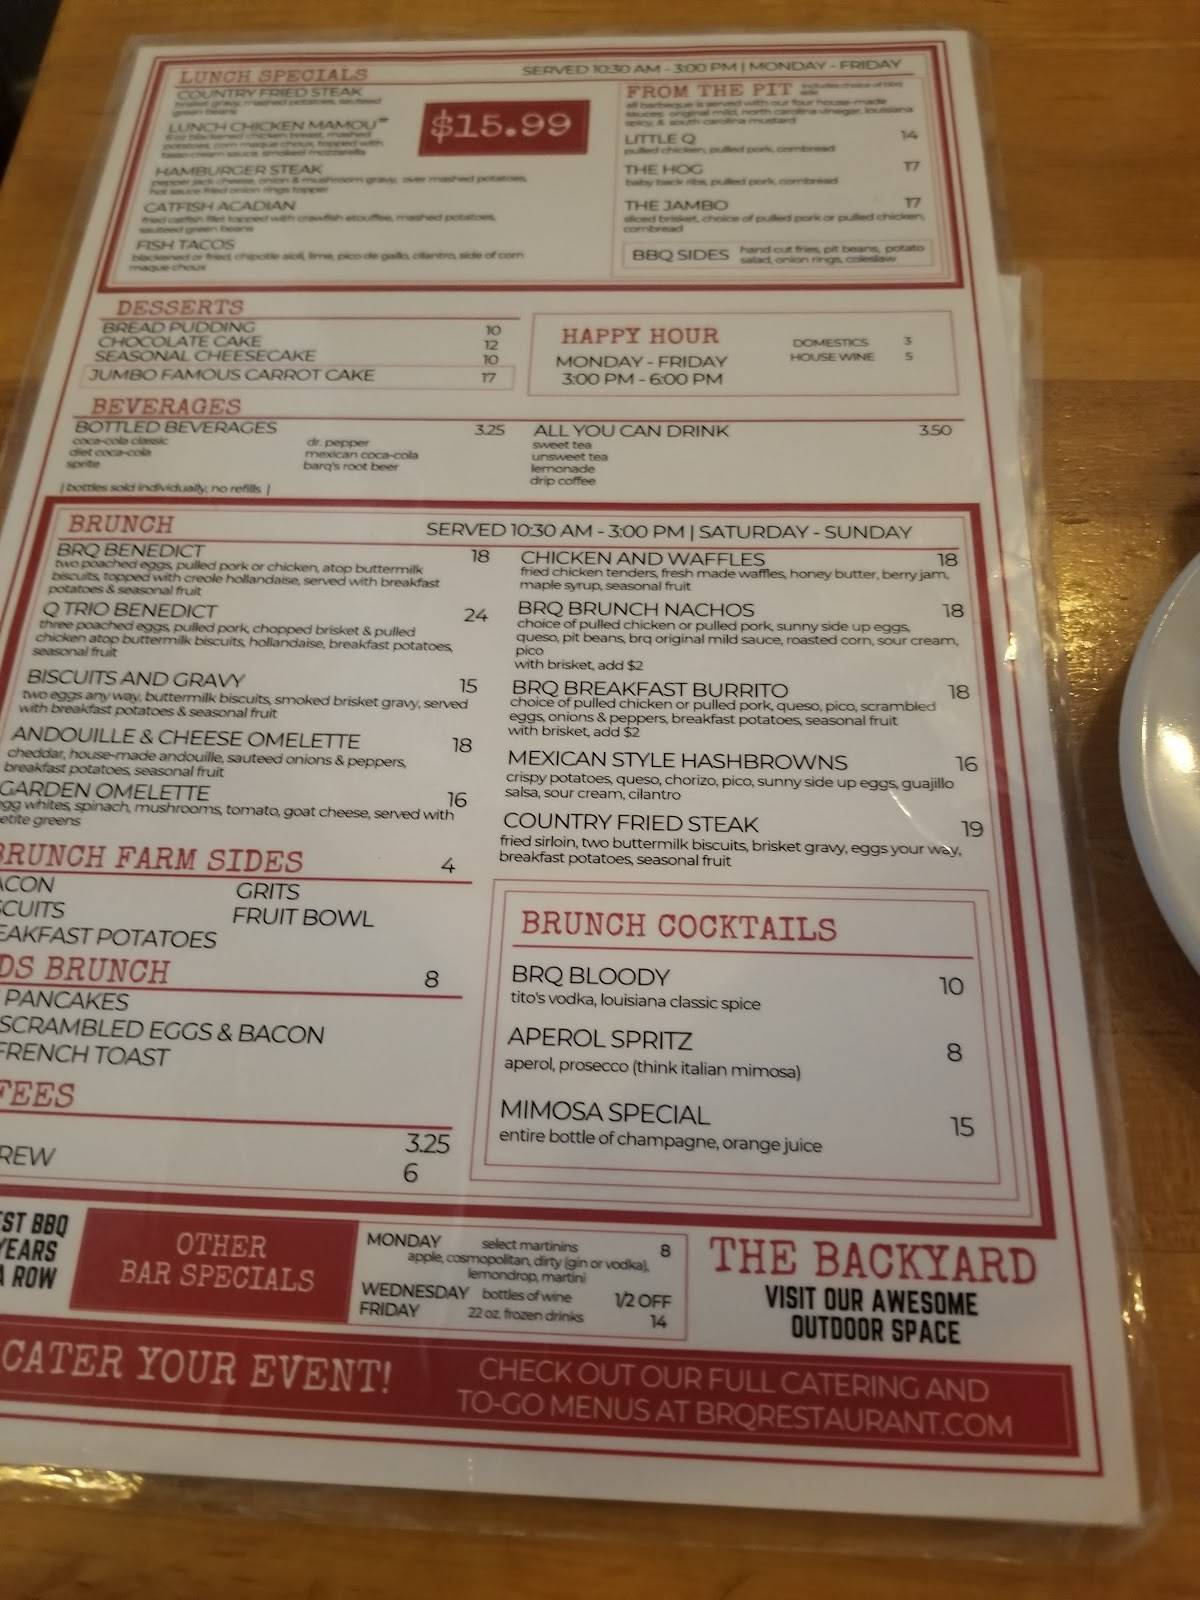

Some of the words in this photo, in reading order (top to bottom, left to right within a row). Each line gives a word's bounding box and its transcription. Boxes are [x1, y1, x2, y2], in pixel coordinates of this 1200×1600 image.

[181, 69, 252, 84] LUNCH
[260, 68, 368, 83] SPECIALS
[523, 64, 590, 75] SERVED
[592, 64, 632, 75] 10:30
[634, 63, 661, 75] AM
[674, 62, 708, 73] 3:00
[710, 61, 738, 72] PM
[749, 60, 827, 72] MONDAY
[840, 58, 902, 70] FRIDAY
[628, 83, 688, 98] FROM
[698, 82, 745, 97] THE
[753, 82, 794, 97] PIT
[431, 109, 572, 143] $15.99
[625, 133, 677, 146] LITTLE
[681, 132, 698, 148] Q
[900, 129, 919, 141] 14
[155, 165, 266, 178] HAMBURGER
[270, 164, 322, 176] STEAK
[624, 164, 658, 175] THE
[662, 164, 704, 176] HOG
[904, 159, 921, 172] 17
[624, 199, 659, 211] THE
[664, 200, 728, 212] JAMBO
[904, 196, 922, 209] 17
[136, 239, 175, 251] FISH
[179, 239, 235, 251] TACOS
[633, 248, 676, 263] BBQ
[677, 248, 730, 261] SIDES
[116, 299, 245, 317] DESSERTS
[103, 321, 167, 333] BREAD
[169, 321, 256, 334] PUDDING
[486, 324, 503, 337] 10
[562, 327, 641, 344] HAPPY
[650, 327, 720, 345] HOUR
[793, 337, 869, 348] DOMESTICS
[904, 336, 912, 345] 3
[556, 355, 643, 369] MONDAY
[659, 355, 728, 368] FRIDAY
[790, 352, 836, 362] HOUSE
[838, 352, 875, 362] WINE
[905, 352, 914, 361] 5
[89, 368, 158, 381] JUMBO
[161, 368, 241, 381] FAMOUS
[244, 366, 322, 381] CARROT
[324, 367, 376, 382] CAKE
[481, 372, 496, 383] 17
[91, 397, 242, 415] BEVERAGES
[75, 420, 161, 434] BOTTLED
[164, 420, 278, 435] BEVERAGES
[474, 422, 506, 436] 3.25
[533, 424, 570, 437] ALL
[572, 424, 616, 437] YOU
[620, 424, 661, 438] CAN
[667, 424, 729, 438] DRINK
[919, 424, 953, 437] 3.50
[305, 449, 360, 460] mexican
[360, 449, 420, 461] coca-cola
[530, 474, 556, 488] drip
[557, 475, 596, 487] coffee
[68, 514, 175, 534] BRUNCH
[57, 543, 101, 559] BRQ
[104, 543, 205, 559] BENEDICT
[471, 546, 490, 563] 18
[514, 657, 545, 670] with
[598, 660, 624, 671] add
[627, 659, 643, 672] $2
[27, 669, 117, 686] BISCUITS
[120, 671, 169, 687] AND
[173, 671, 245, 688] GRAVY
[460, 678, 477, 693] 15
[11, 726, 136, 744] ANDOUILLE
[140, 728, 153, 744] &
[158, 729, 243, 747] CHEESE
[248, 731, 361, 749] OMELETTE
[452, 738, 472, 753] 18
[509, 750, 606, 767] MEXICAN
[612, 751, 675, 768] STYLE
[682, 753, 848, 770] HASHBROWNS
[954, 756, 979, 773] 16
[506, 771, 548, 787] crispy
[757, 778, 802, 790] sunny
[804, 776, 833, 788] side
[837, 779, 857, 791] up
[901, 777, 954, 792] guajillo
[115, 846, 197, 870] FARM
[207, 848, 303, 873] SIDES
[441, 857, 456, 874] 4
[236, 882, 300, 900] GRITS
[233, 907, 299, 925] FRUIT
[303, 908, 374, 927] BOWL
[522, 910, 646, 937] BRUNCH
[658, 914, 837, 942] COCKTAILS
[44, 957, 172, 983] BRUNCH
[425, 970, 439, 988] 8
[513, 965, 563, 987] BRQ
[570, 966, 670, 986] BLOODY
[939, 977, 964, 995] 10
[5, 989, 129, 1011] PANCAKES
[511, 991, 545, 1004] tito's
[601, 993, 666, 1008] louisiana
[670, 995, 718, 1009] classic
[721, 997, 761, 1013] spice
[508, 1027, 606, 1048] APEROL
[611, 1029, 692, 1050] SPRITZ
[947, 1043, 962, 1062] 8
[501, 1099, 603, 1121] MIMOSA
[609, 1102, 711, 1125] SPECIAL
[950, 1117, 974, 1137] 15
[405, 1133, 450, 1154] 3.25
[403, 1163, 418, 1183] 6
[31, 1212, 69, 1239] BBQ
[177, 1232, 266, 1259] OTHER
[367, 1232, 441, 1249] MONDAY
[710, 1236, 796, 1274] THE
[813, 1241, 1036, 1283] BACKYARD
[11, 1264, 58, 1290] ROW
[120, 1259, 171, 1285] BAR
[180, 1263, 314, 1292] SPECIALS
[362, 1283, 470, 1300] WEDNESDAY
[615, 1291, 635, 1309] 1/2
[638, 1294, 673, 1309] OFF
[765, 1285, 816, 1310] VISIT
[825, 1287, 863, 1312] OUR
[872, 1290, 978, 1316] AWESOME
[360, 1301, 420, 1317] FRIDAY
[650, 1314, 668, 1328] 14
[792, 1315, 883, 1341] OUTDOOR
[892, 1318, 960, 1345] SPACE
[2, 1339, 123, 1378] CATER
[137, 1346, 236, 1385] YOUR
[250, 1354, 392, 1393] EVENT!
[479, 1357, 572, 1383] CHECK
[578, 1362, 636, 1387] OUT
[640, 1364, 702, 1390] OUR
[709, 1367, 776, 1394] FULL
[781, 1371, 919, 1399] CATERING
[925, 1378, 990, 1402] AND
[457, 1389, 544, 1423] TO-GO
[551, 1394, 650, 1426] MENUS
[655, 1399, 691, 1423] AT
[696, 1401, 1012, 1437] BRQRESTAURANT.COM
